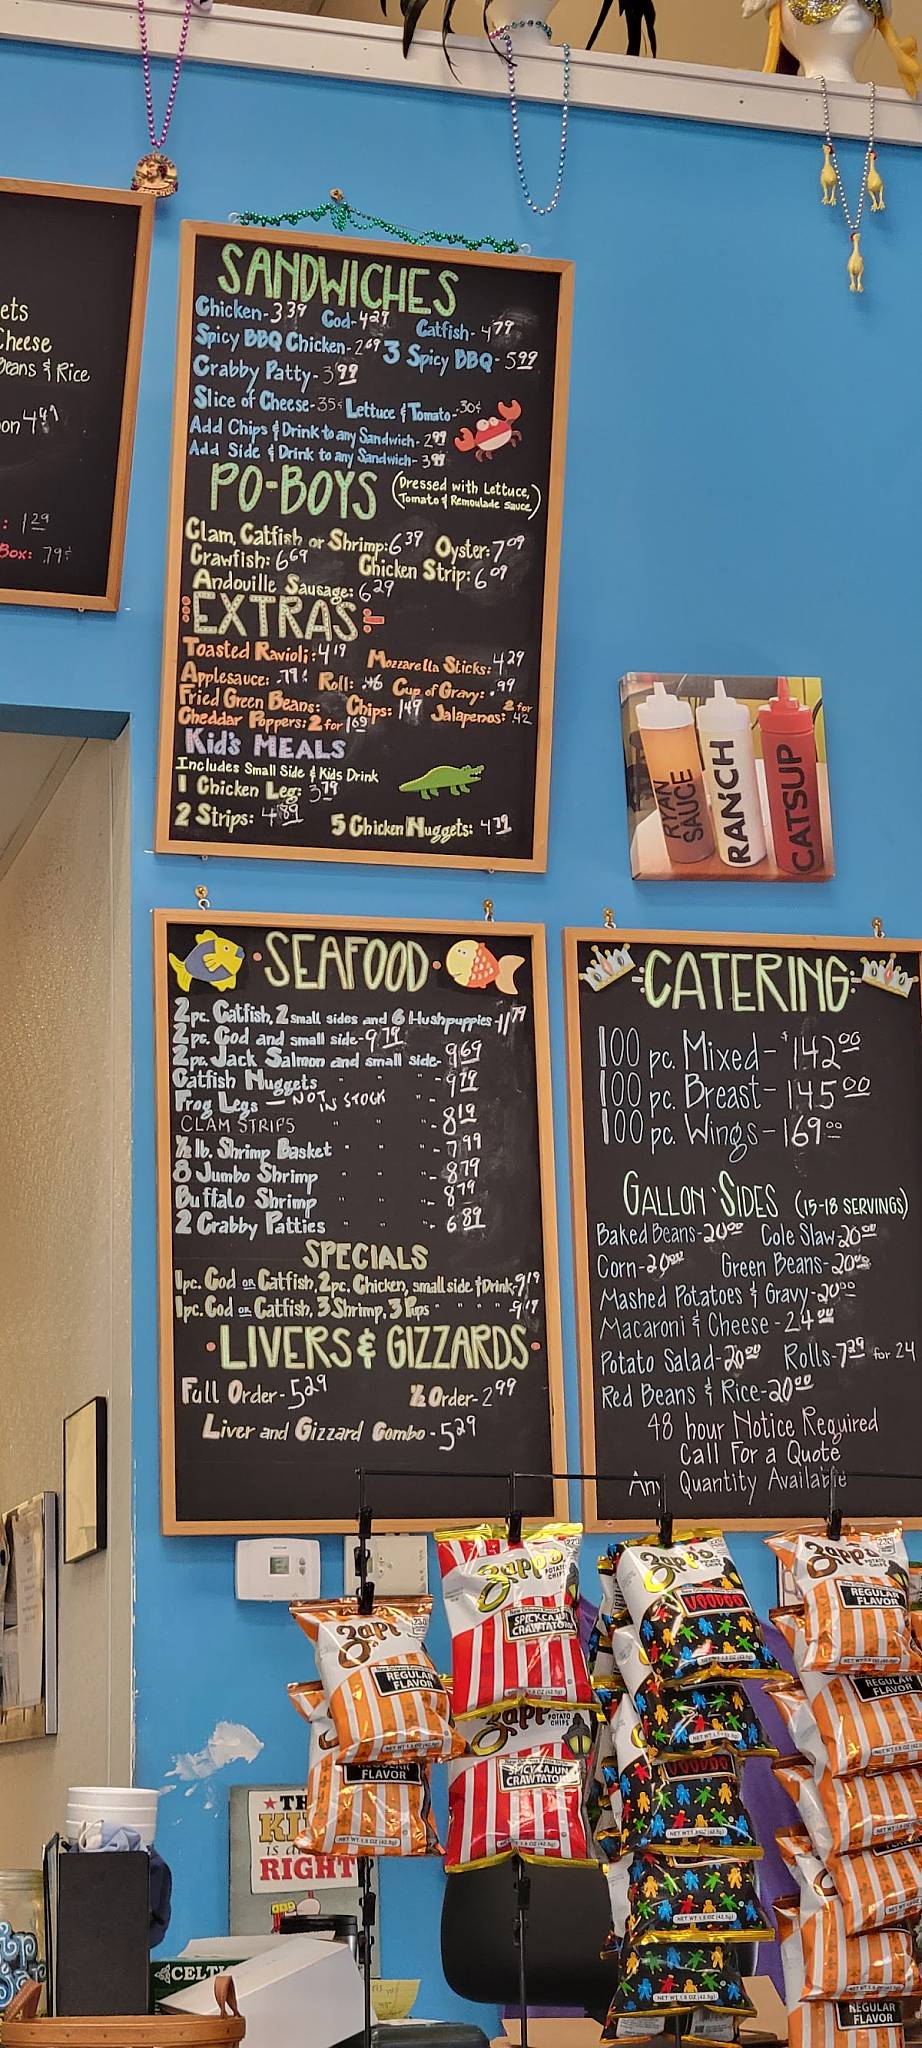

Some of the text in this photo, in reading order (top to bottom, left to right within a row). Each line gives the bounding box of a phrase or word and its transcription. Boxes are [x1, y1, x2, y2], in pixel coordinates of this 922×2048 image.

[217, 243, 460, 317] SANDWICHES
[195, 323, 283, 351] Spicy BBQ
[56, 362, 90, 382] Rice
[406, 344, 449, 376] Spicy
[193, 354, 260, 393] Crabby
[194, 385, 255, 409] Slice of
[346, 398, 396, 420] Lettuce
[190, 416, 356, 449] Add Chips Drink to any
[189, 440, 354, 469] Add Side Drink to any
[210, 462, 378, 520] PO-BOYS
[452, 480, 478, 495] with
[399, 493, 500, 509] Tomato Remoulade
[240, 522, 325, 549] Catfish or
[359, 554, 417, 579] Chicken
[193, 590, 358, 642] EXTRAS
[183, 636, 249, 660] Toasted
[367, 649, 439, 673] Mozzarella
[179, 684, 264, 709] Fried Green
[392, 678, 420, 702] Cup
[178, 706, 243, 726] Cheddar
[185, 728, 346, 760] Kid's MEALS
[175, 757, 379, 783] Includes Small Side Kids Drink
[196, 775, 259, 797] Chicken
[174, 802, 192, 826] 2
[653, 780, 680, 839] RYAN
[670, 768, 704, 844] SAUCE
[709, 740, 751, 864] RANCH
[776, 744, 815, 874] CATSUP
[331, 813, 403, 837] 5 Chicken
[264, 930, 430, 992] SEAFOOD
[644, 950, 849, 1012] CATERING
[276, 1004, 405, 1025] 2 small sides and 6
[214, 1025, 325, 1046] Cod and small
[210, 1045, 402, 1068] Jack Salmon and small
[599, 1026, 760, 1079] 100 pc. Mixed
[172, 1068, 317, 1096] Catfish Nuggets
[600, 1070, 762, 1119] 100 pc. Breast
[174, 1090, 258, 1120] Frog Legs
[181, 1115, 295, 1134] CLAM STRIPS
[602, 1109, 758, 1162] 100 pc. Wings
[217, 1137, 332, 1163] Shrimp Basket
[172, 1160, 318, 1195] 8 Jumbo Shrimp
[175, 1185, 317, 1219] Buffalo Shrimp
[623, 1171, 705, 1216] GALLON
[175, 1209, 326, 1241] 2 Crabby Patties
[597, 1222, 648, 1245] Baked
[761, 1224, 795, 1246] Cole
[302, 1238, 428, 1270] SPECIALS
[722, 1252, 766, 1278] Green
[204, 1266, 473, 1294] Cod small side
[204, 1295, 331, 1318] Cod 3
[600, 1284, 743, 1311] Mashed Potatoes
[600, 1312, 770, 1340] Macaroni Cheese
[220, 1325, 529, 1370] LIVERS GIZZARDS
[873, 1341, 916, 1362] for 24
[601, 1351, 654, 1375] Potato
[181, 1377, 219, 1404] Full
[602, 1383, 695, 1409] Red Beans
[202, 1413, 364, 1442] Liver and Gizzard
[648, 1406, 879, 1445] 48 hour Notice Required
[680, 1440, 841, 1466] Call For a Quote
[680, 1469, 757, 1506] Quantity
[684, 1594, 744, 1611] VOODOO
[851, 1588, 899, 1599] REGULAR
[857, 1597, 898, 1607] FLAVOR
[386, 1671, 434, 1681] REGULAR
[394, 1680, 433, 1690] FLAVOR
[866, 1676, 913, 1687] REGULAR
[873, 1683, 913, 1696] FLAVOR
[361, 1769, 406, 1779] FLAVOR
[260, 1856, 355, 1880] RIGHT
[849, 2002, 896, 2013] REGULAR
[853, 2013, 893, 2025] FLAVOR
